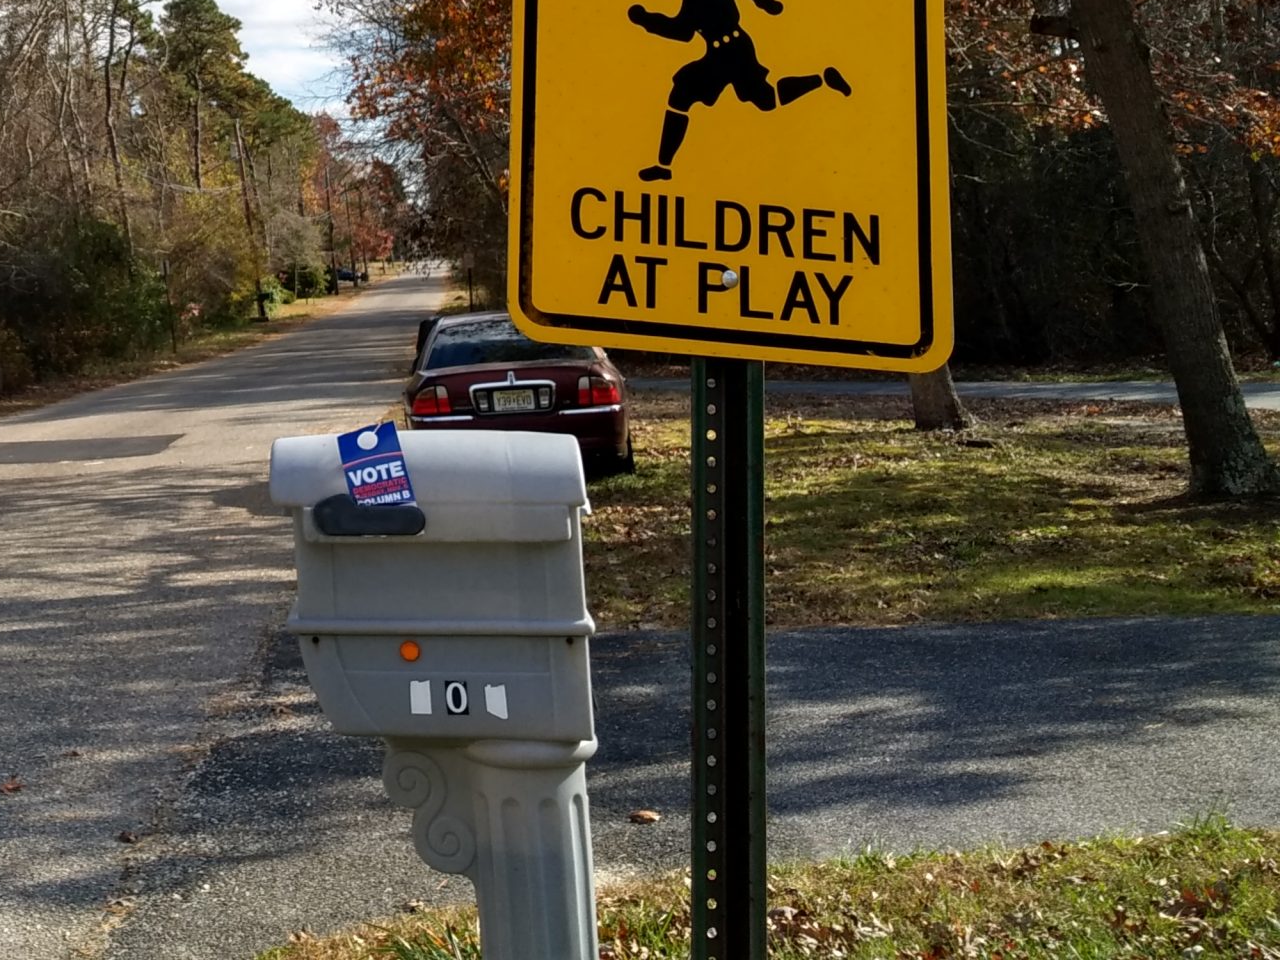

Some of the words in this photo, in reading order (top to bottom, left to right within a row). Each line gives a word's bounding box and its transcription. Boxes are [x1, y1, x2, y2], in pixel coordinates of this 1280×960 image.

[570, 187, 881, 265] CHILDREN
[598, 254, 667, 308] AT
[698, 262, 853, 325] PLAY
[348, 460, 405, 487] VOTE
